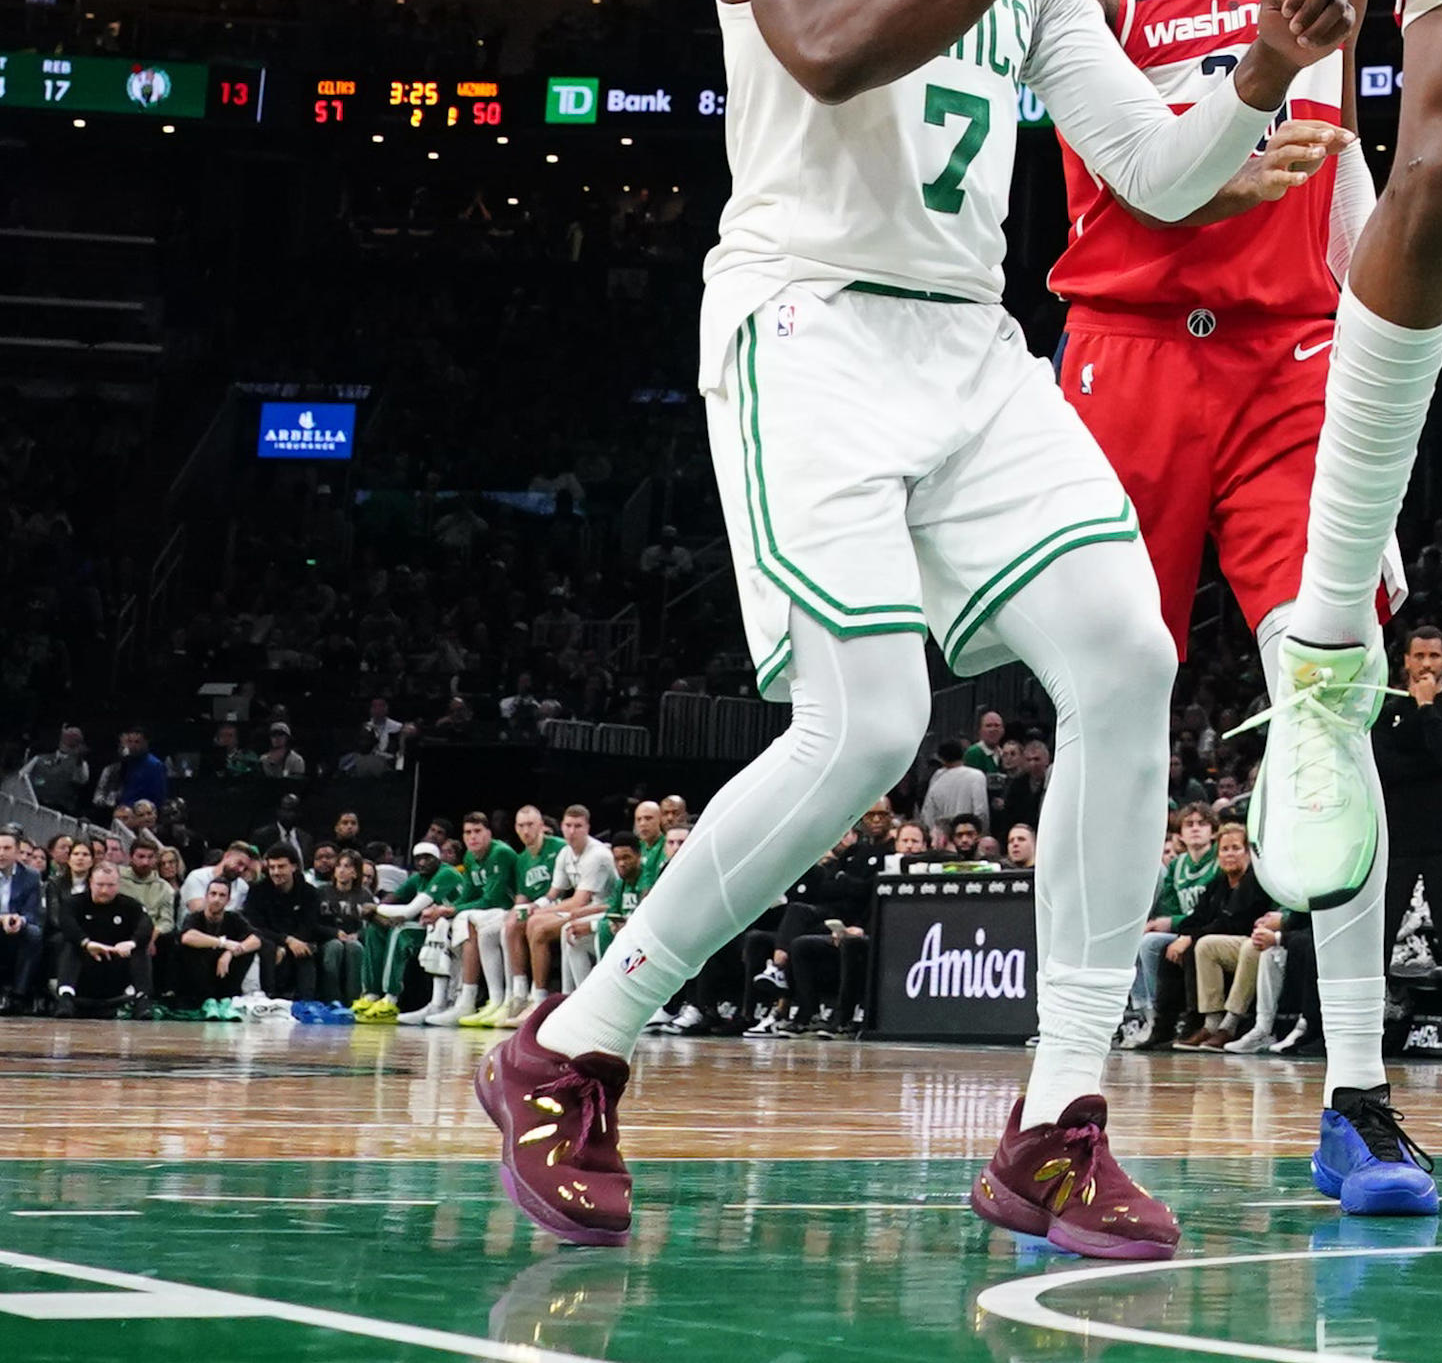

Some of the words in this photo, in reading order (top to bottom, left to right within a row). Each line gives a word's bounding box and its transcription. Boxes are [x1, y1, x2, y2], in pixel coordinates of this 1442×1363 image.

[43, 79, 72, 102] 17
[220, 82, 249, 106] 13
[389, 82, 438, 105] 3:25
[552, 85, 594, 116] TD
[607, 89, 671, 114] Bank
[314, 99, 344, 123] 57
[473, 101, 501, 125] 50
[923, 85, 991, 214] 7
[906, 922, 1026, 999] Amica
